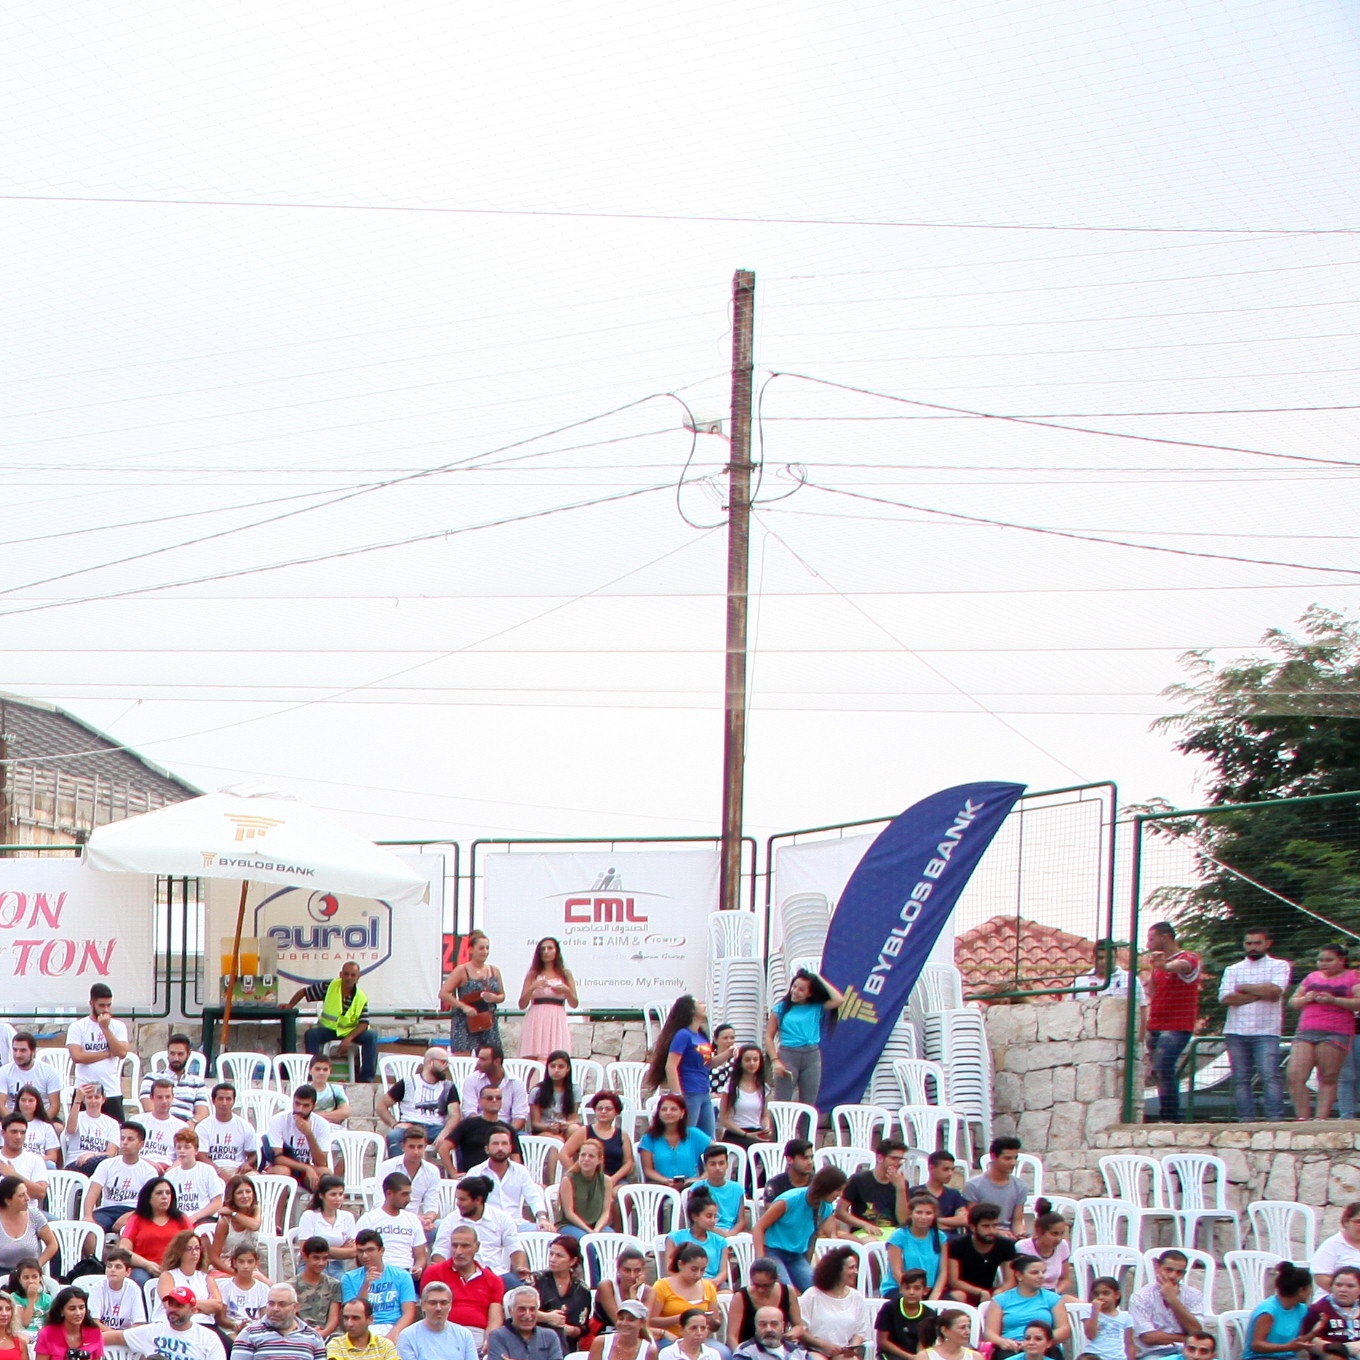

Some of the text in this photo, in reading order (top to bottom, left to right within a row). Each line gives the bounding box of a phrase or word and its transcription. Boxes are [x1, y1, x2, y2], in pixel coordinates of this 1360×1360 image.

[219, 857, 317, 877] BYBLOS BANK
[863, 799, 985, 996] BYBLOS BANK
[564, 898, 648, 923] CML
[267, 916, 380, 950] eurol
[607, 937, 630, 946] AIM
[632, 937, 640, 946] &
[13, 938, 117, 976] TON
[277, 952, 379, 961] UBRICANTS
[636, 977, 651, 988] My
[375, 1225, 413, 1236] adidas
[154, 1336, 191, 1353] OUT
